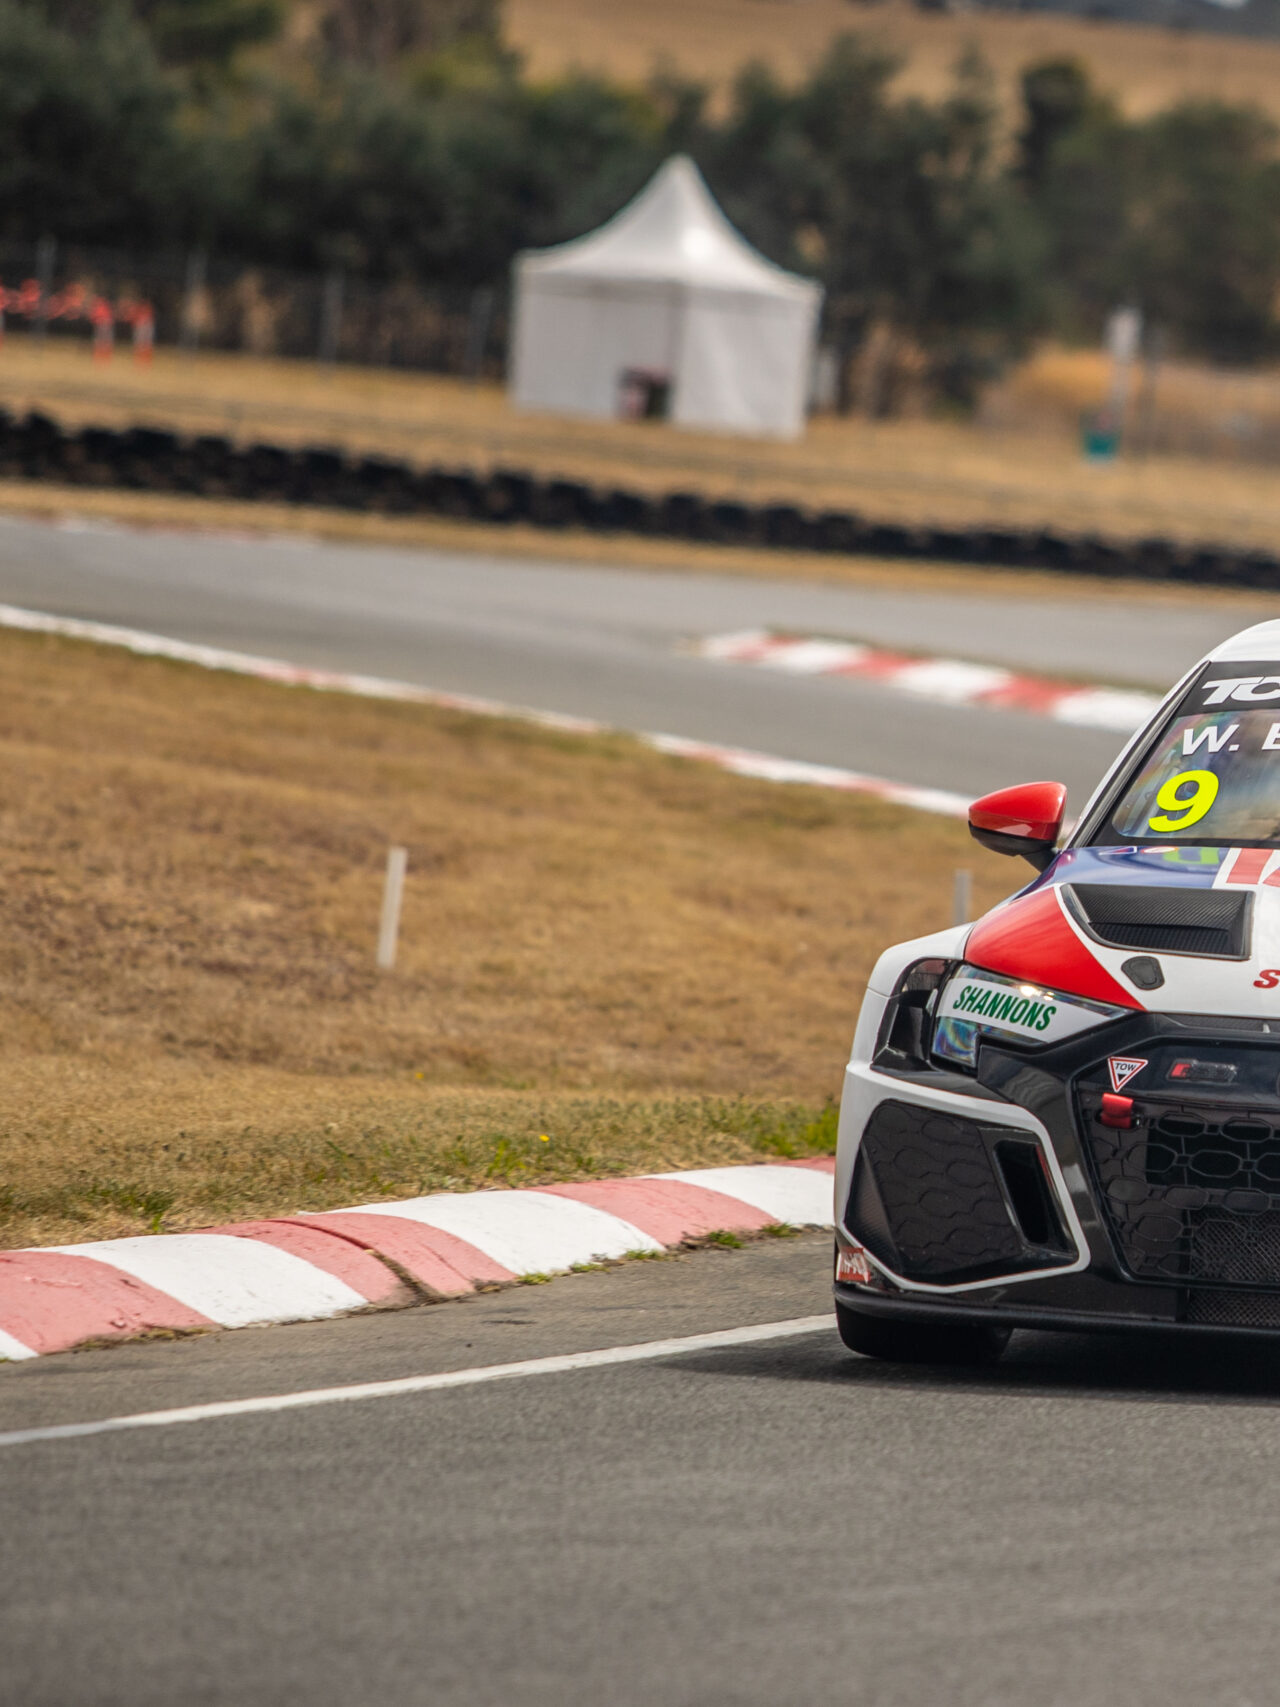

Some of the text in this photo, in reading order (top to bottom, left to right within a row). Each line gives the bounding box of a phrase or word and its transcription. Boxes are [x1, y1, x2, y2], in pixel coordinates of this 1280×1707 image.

[1182, 723, 1240, 756] W.
[1148, 769, 1219, 833] 9
[952, 984, 1057, 1032] SHANNONS
[1115, 1062, 1138, 1072] TOW
